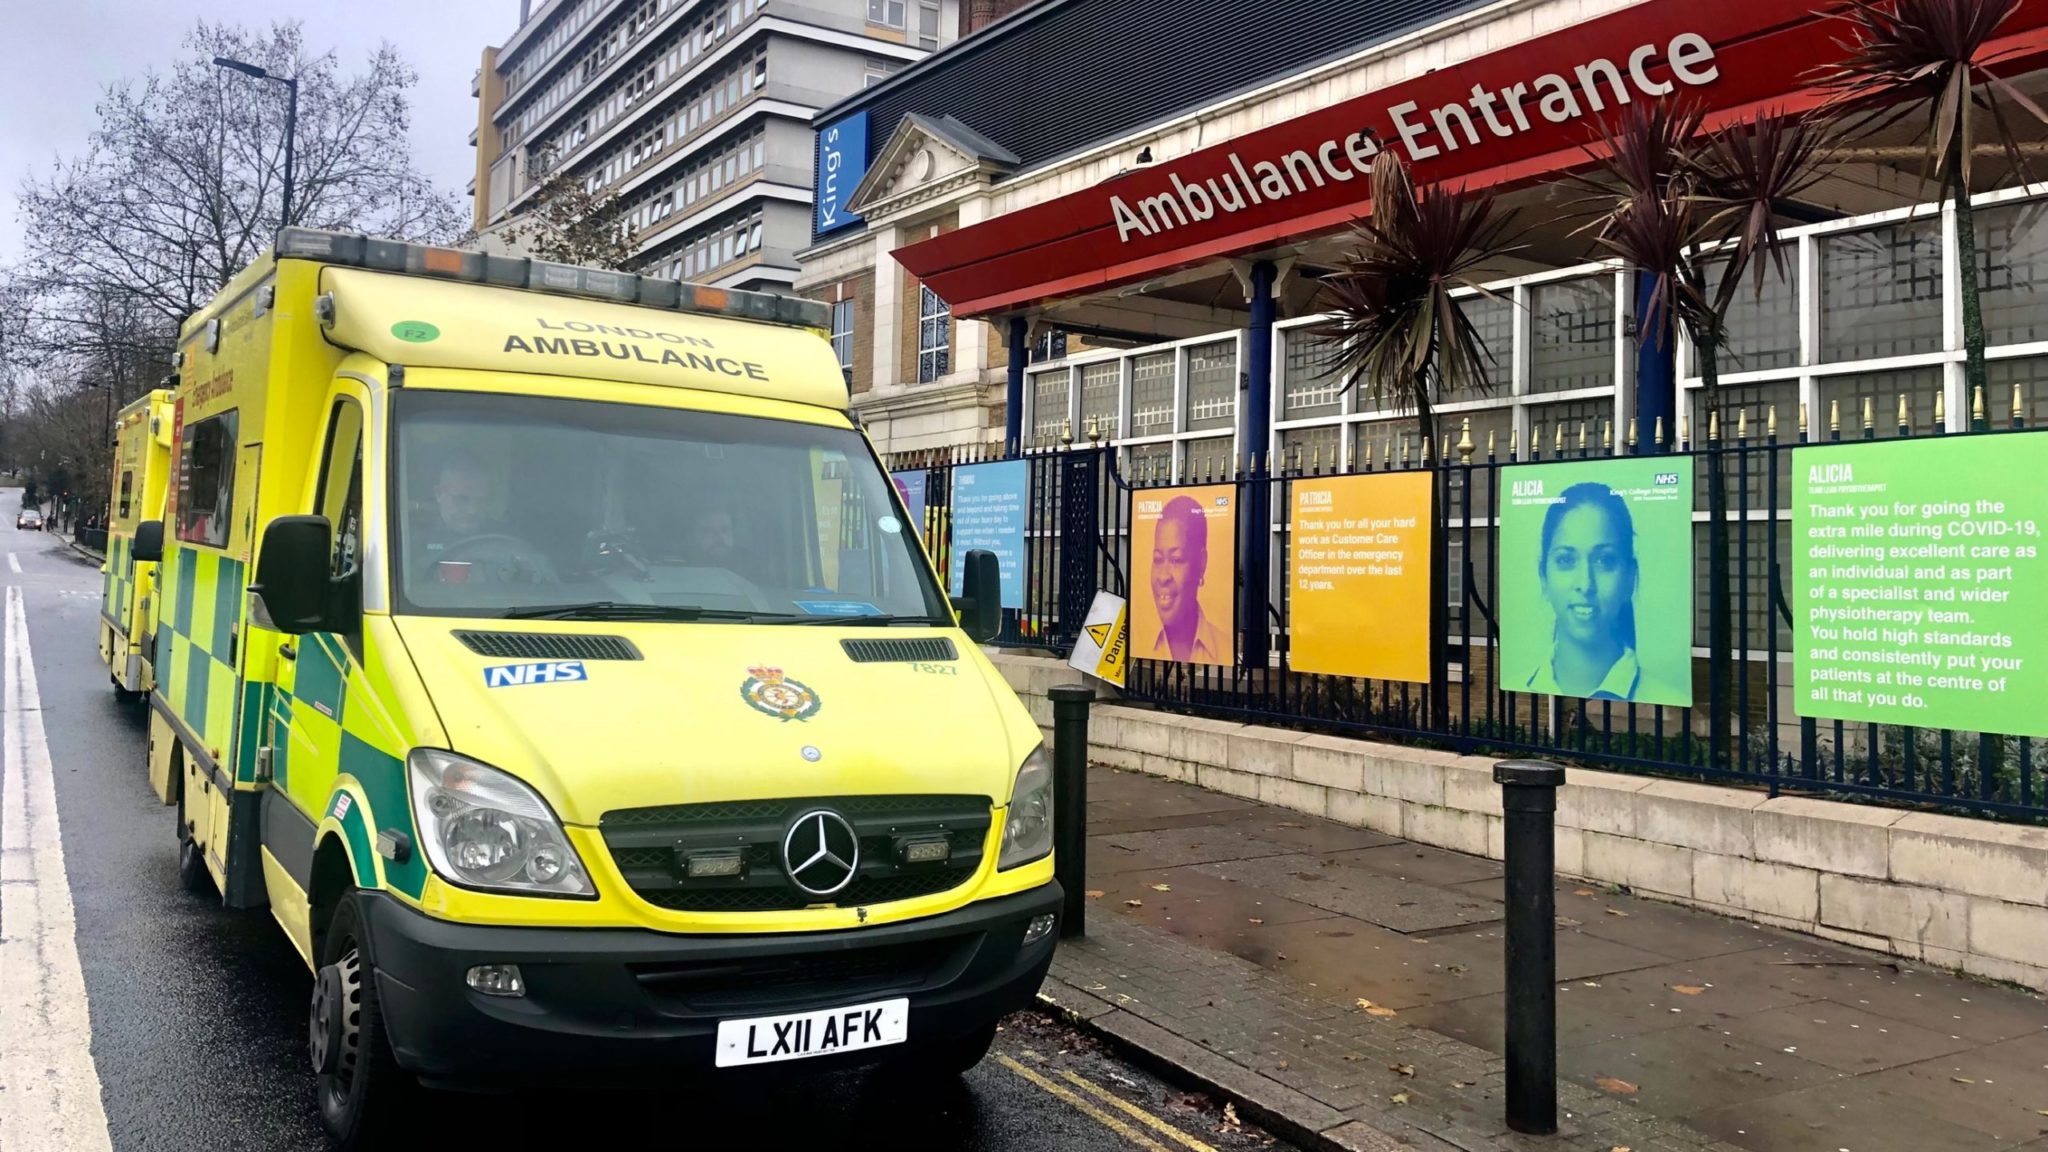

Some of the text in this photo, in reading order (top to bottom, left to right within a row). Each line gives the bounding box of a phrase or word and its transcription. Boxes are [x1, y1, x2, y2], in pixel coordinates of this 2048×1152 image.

[1109, 31, 1720, 243] Ambulance Entrance
[823, 128, 841, 227] King's
[537, 318, 715, 349] LONDON
[504, 335, 770, 382] AMBULANCE
[1656, 474, 1678, 484] NHS
[1809, 464, 1853, 483] ALICIA
[1512, 480, 1543, 496] ALICIA
[1809, 500, 2004, 520] Thank you for going the
[1300, 517, 1415, 531] Thank you for all your hard
[1809, 520, 2040, 539] extra mile during COVID-19,
[1299, 534, 1398, 544] work as Customer Care
[1299, 550, 1403, 562] Officer in the emergency
[1809, 544, 2037, 560] delivering excellent care as
[1299, 565, 1402, 576] department over the last
[1809, 565, 2012, 583] an individual and as part
[1300, 580, 1334, 591] 12 years.
[1810, 586, 2009, 602] of a specialist and wider
[1810, 606, 1974, 625] physiotherapy team.
[1105, 619, 1126, 664] Dange
[1811, 626, 2012, 647] You hold high standards
[911, 662, 957, 676] 7827
[1810, 647, 2022, 672] and consistently put your
[489, 663, 582, 686] NHS
[1811, 667, 2006, 692] patients at the centre of
[1811, 687, 1927, 708] all that you do.
[747, 1008, 883, 1058] LX11 AFK
